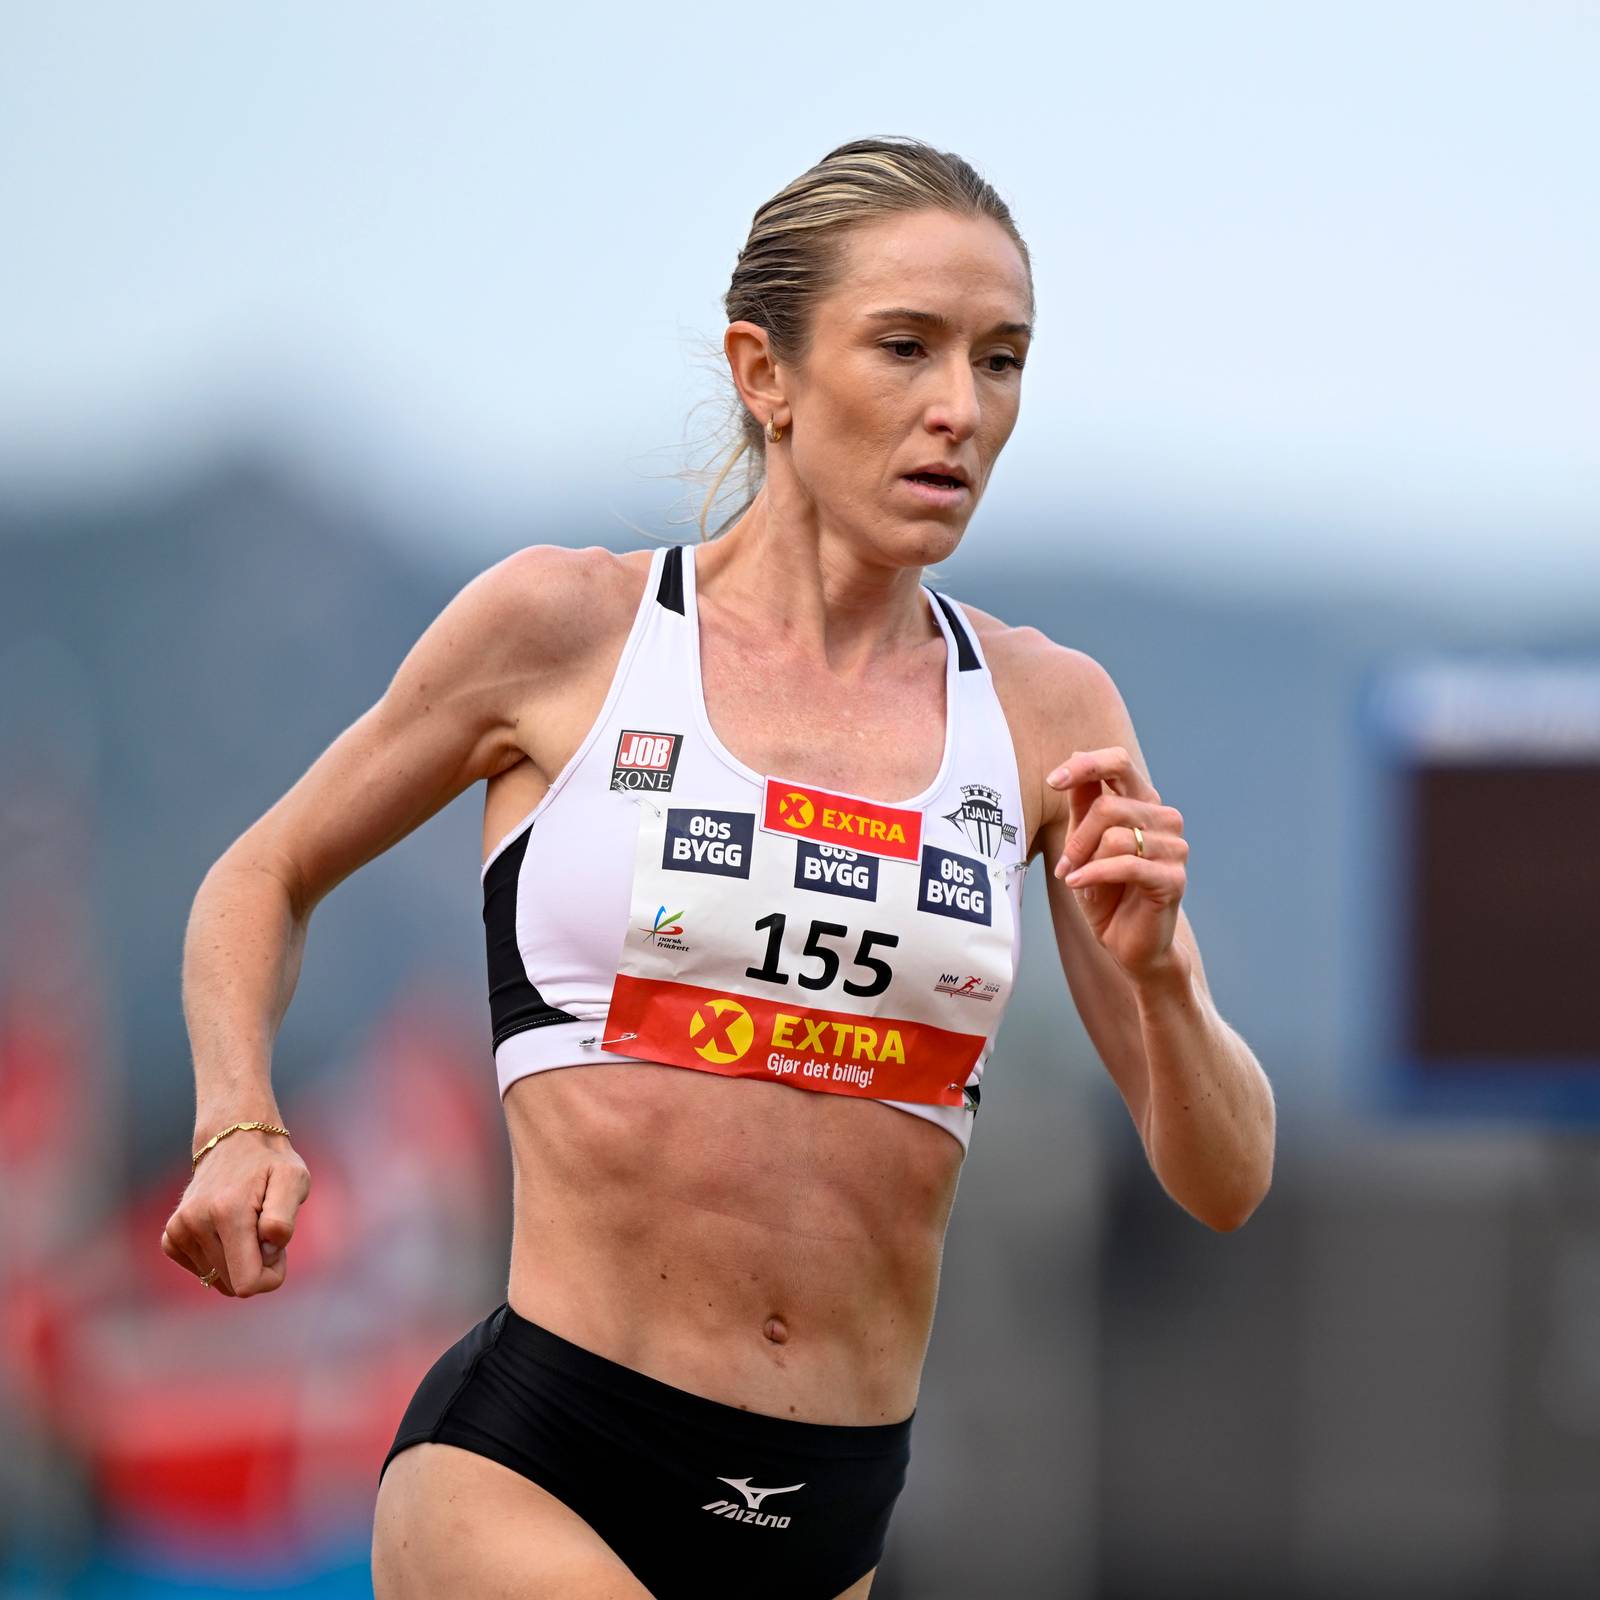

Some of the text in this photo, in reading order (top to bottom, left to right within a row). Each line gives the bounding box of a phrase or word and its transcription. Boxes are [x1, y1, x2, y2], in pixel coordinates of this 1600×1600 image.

[620, 736, 670, 767] JOB
[614, 771, 671, 790] ZONE
[822, 809, 906, 844] EXTRA
[963, 805, 1002, 824] TJALVE
[673, 837, 742, 867] BYGG
[804, 856, 869, 890] BYGG
[927, 879, 984, 914] BYGG
[658, 936, 682, 945] norsk
[745, 912, 899, 997] 155
[938, 973, 959, 985] NM
[983, 985, 999, 993] 2024
[771, 1013, 906, 1065] EXTRA
[767, 1052, 874, 1089] Gjør det billig!
[701, 1500, 791, 1529] MIZUNO
